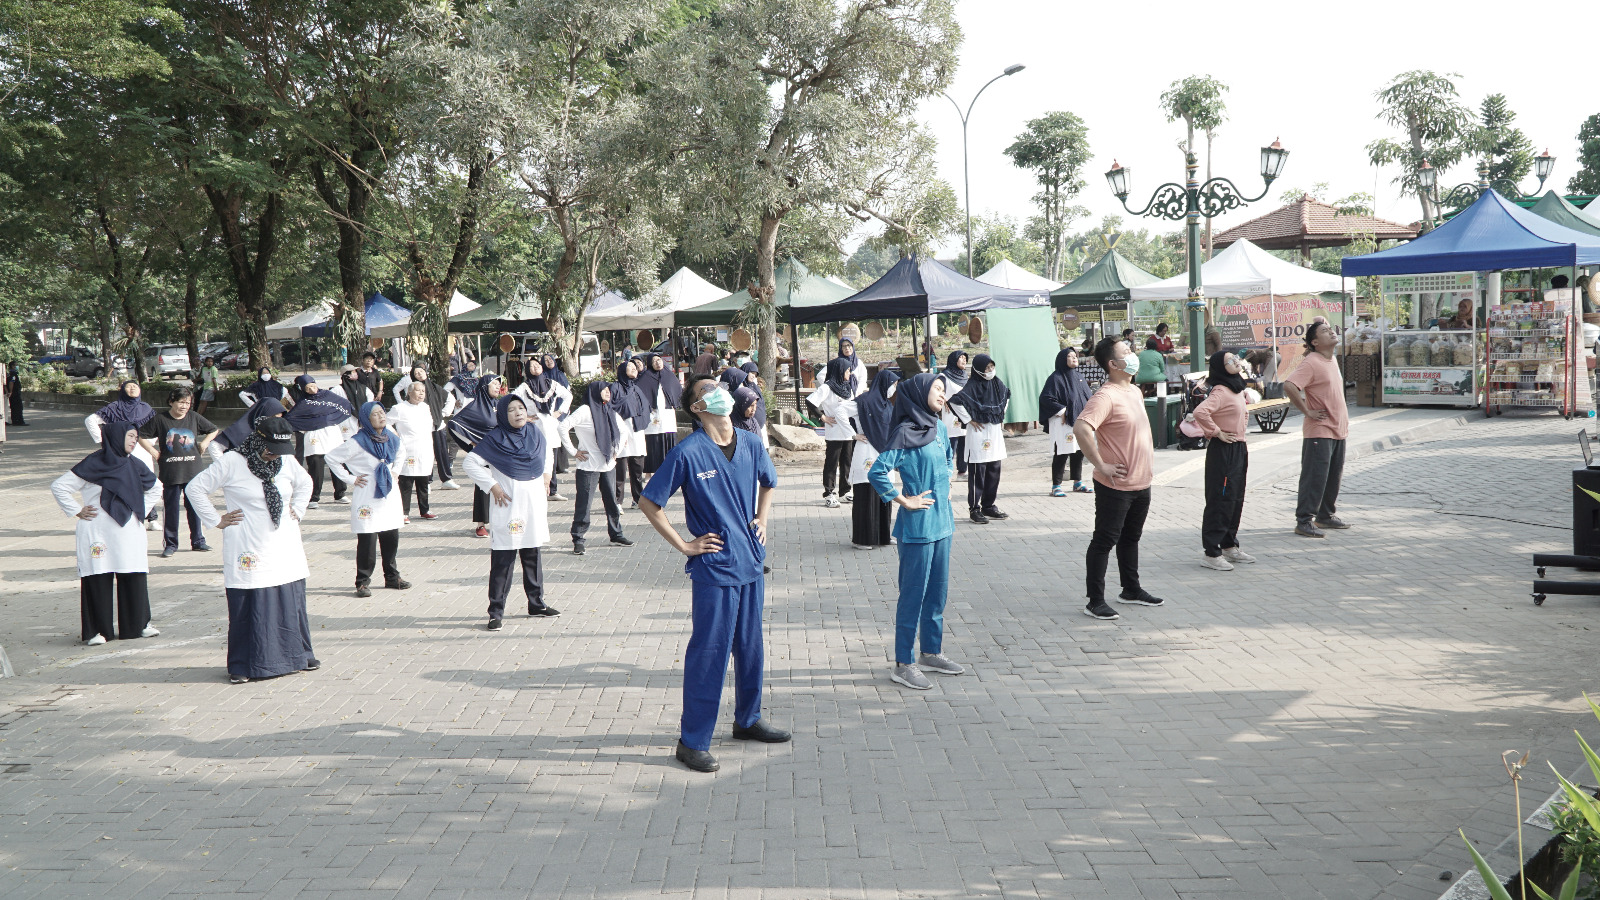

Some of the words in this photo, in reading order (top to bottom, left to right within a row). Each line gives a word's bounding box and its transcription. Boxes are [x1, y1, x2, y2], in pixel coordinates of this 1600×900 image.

[1220, 303, 1255, 316] WARUNG
[1256, 300, 1299, 313] KELOMPOK
[1400, 372, 1421, 380] CITRA
